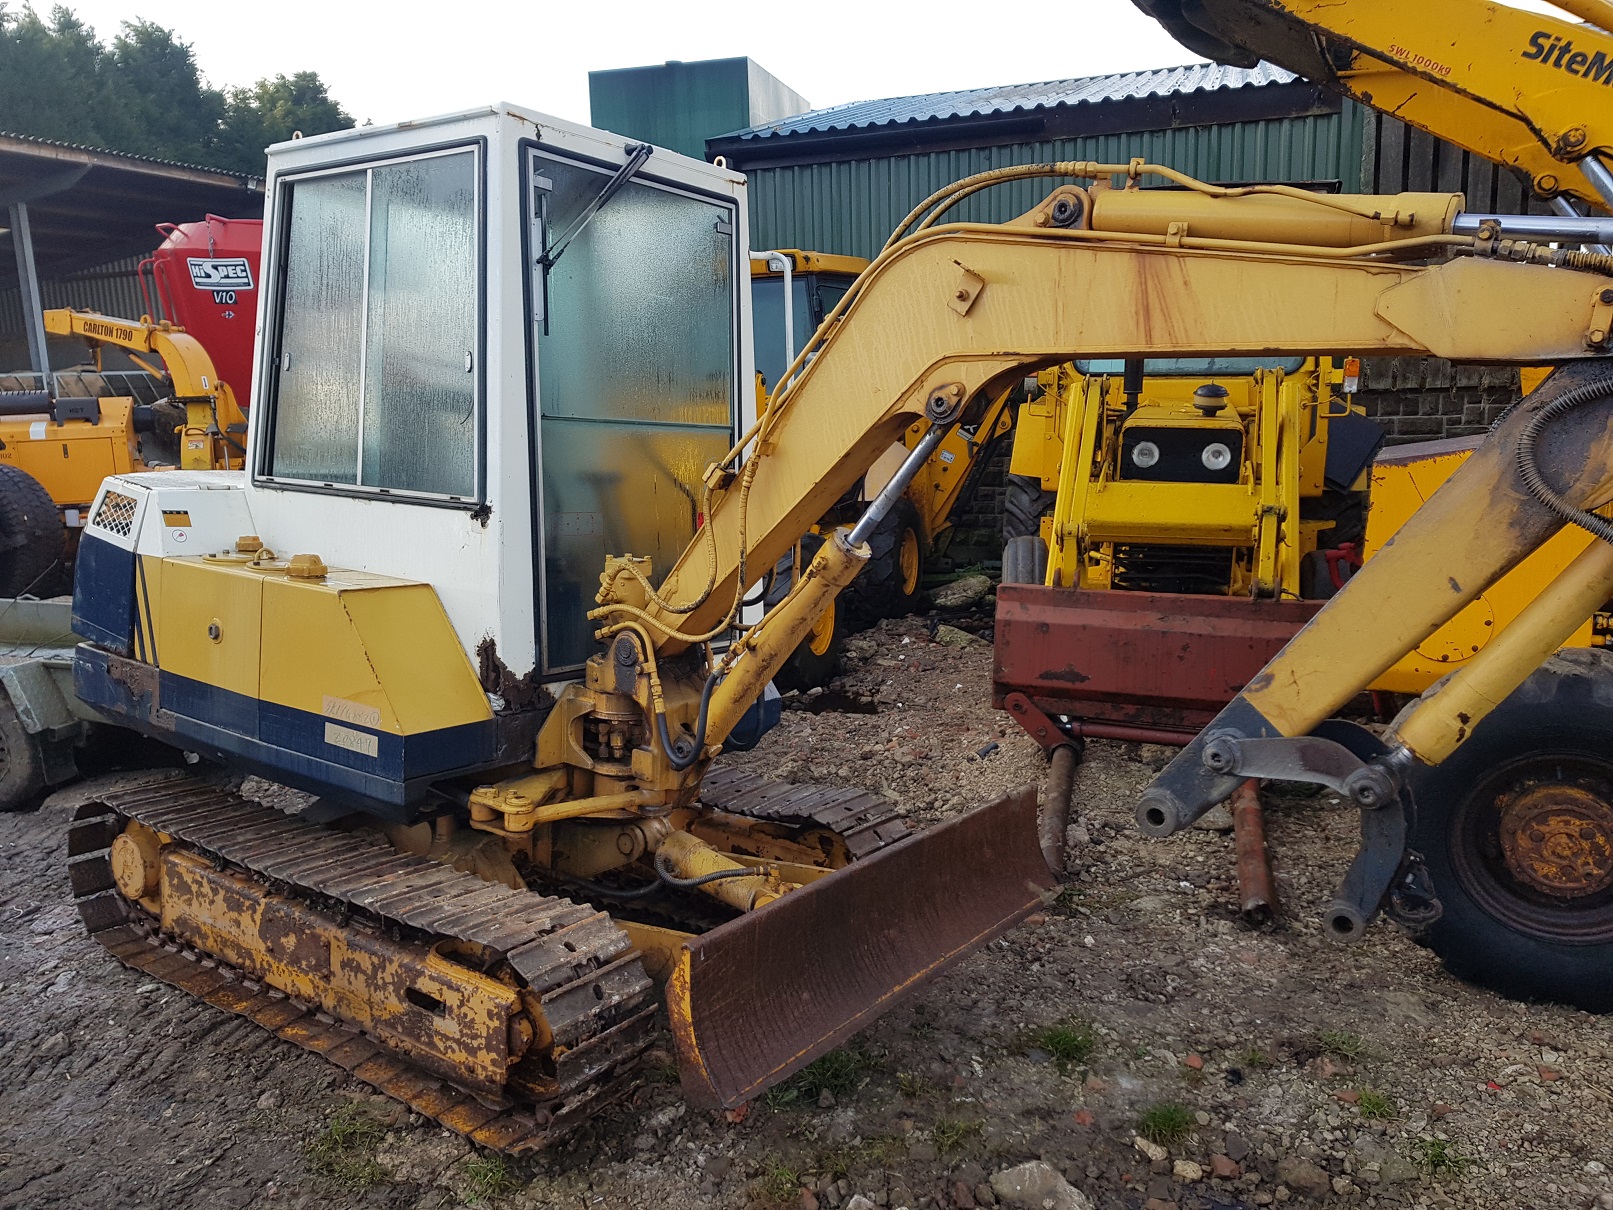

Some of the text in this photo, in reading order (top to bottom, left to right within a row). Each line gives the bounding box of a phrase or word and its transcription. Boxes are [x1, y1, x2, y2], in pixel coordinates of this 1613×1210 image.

[1388, 44, 1452, 76] SWL 1000kg
[1521, 30, 1613, 88] SiteM
[213, 291, 236, 304] V10
[83, 321, 133, 342] CARLTON 1790
